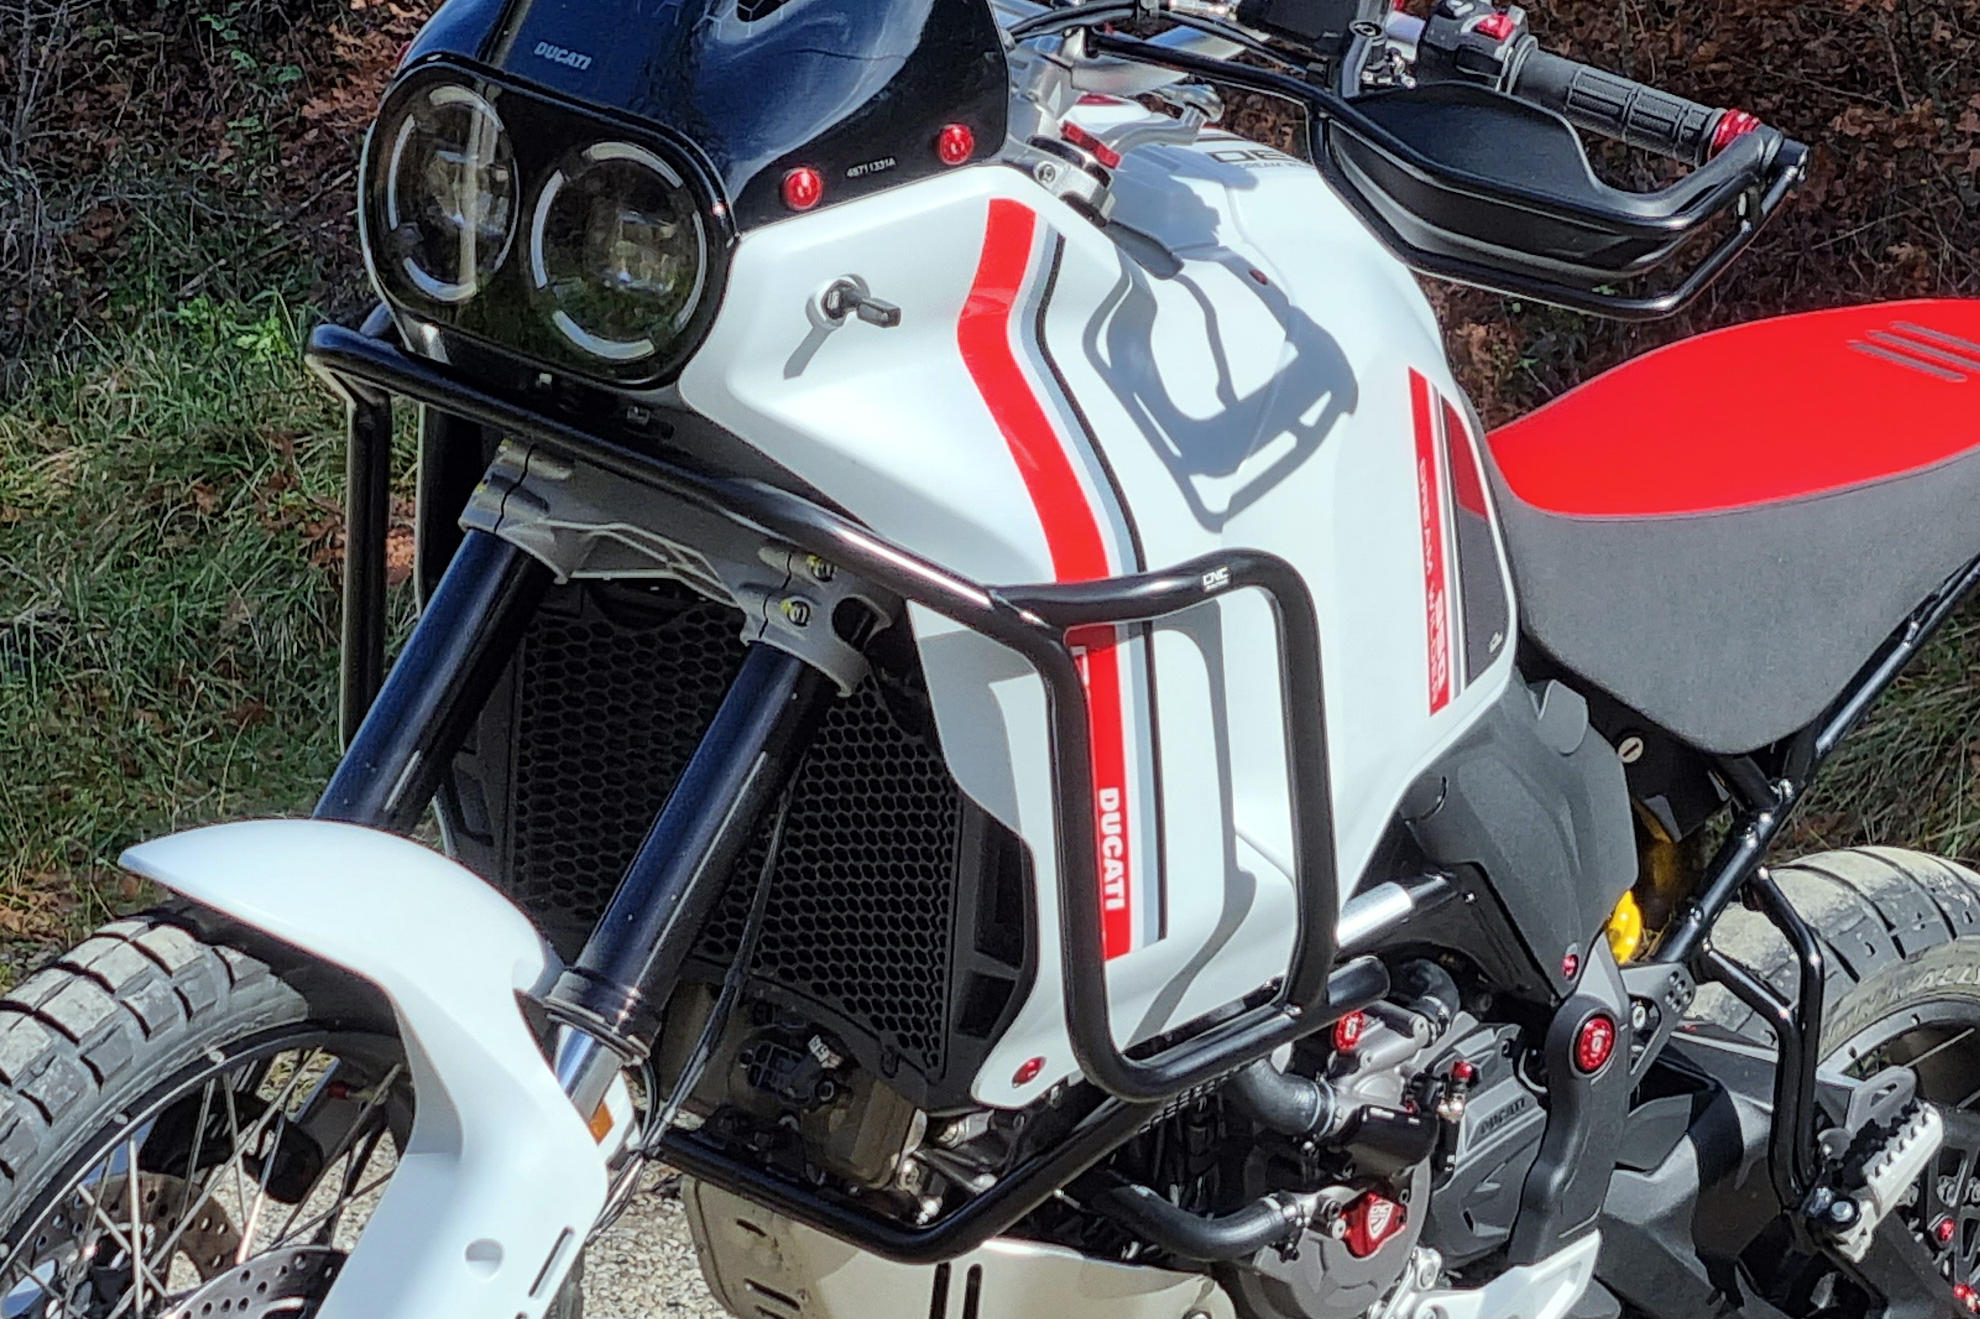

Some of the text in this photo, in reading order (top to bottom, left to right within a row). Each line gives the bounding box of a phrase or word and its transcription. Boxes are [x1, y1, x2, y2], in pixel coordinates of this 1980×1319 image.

[534, 41, 592, 70] DUCATI
[1419, 457, 1433, 576] DREAM
[1202, 566, 1229, 586] CNC
[1099, 786, 1125, 910] DUCATI
